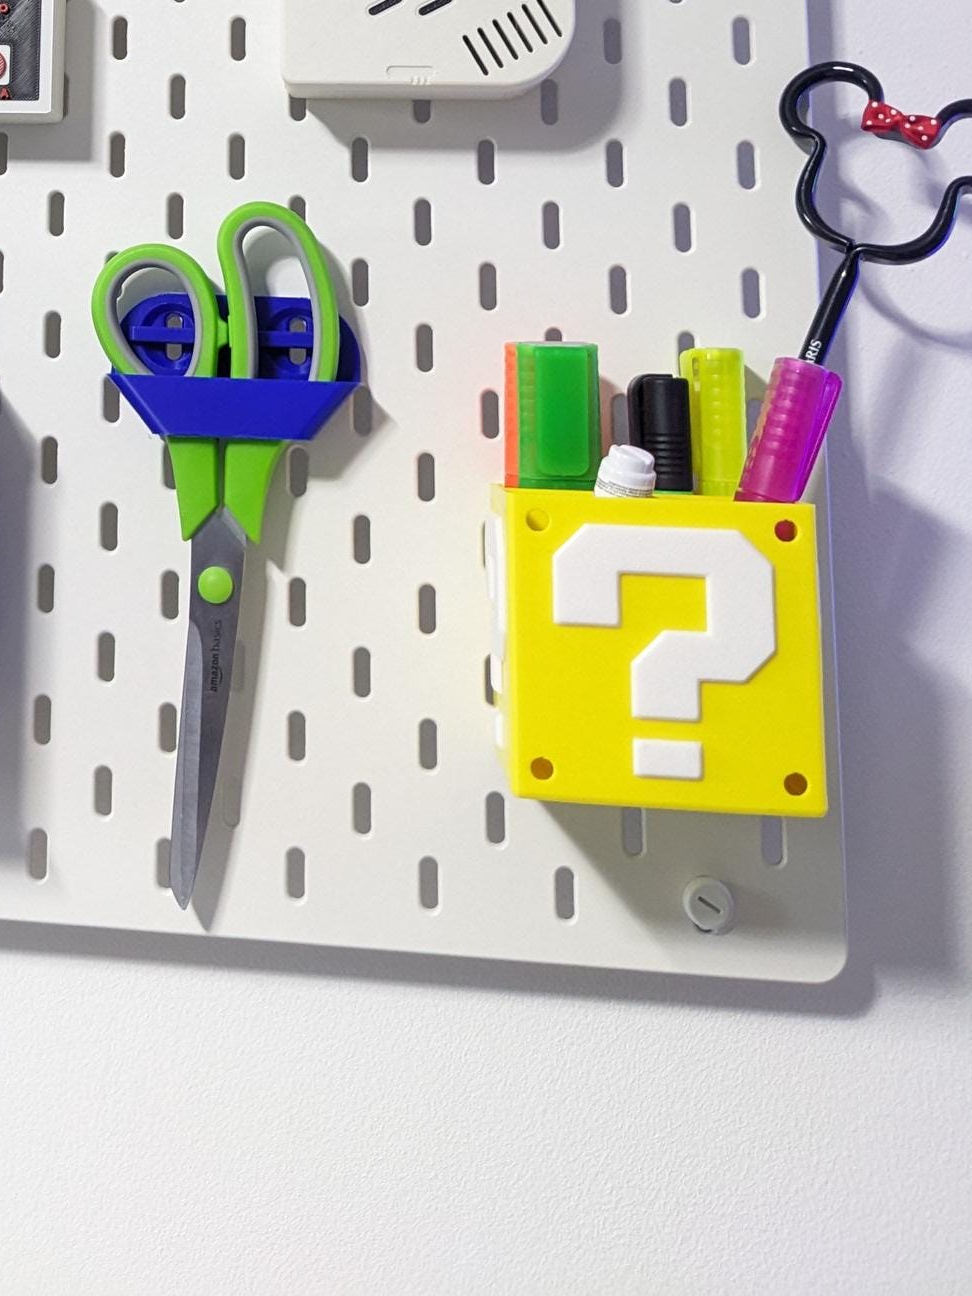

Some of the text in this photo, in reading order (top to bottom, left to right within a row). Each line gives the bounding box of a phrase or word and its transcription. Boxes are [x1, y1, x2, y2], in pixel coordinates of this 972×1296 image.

[210, 619, 222, 692] amazon basics
[552, 522, 778, 780] ?
